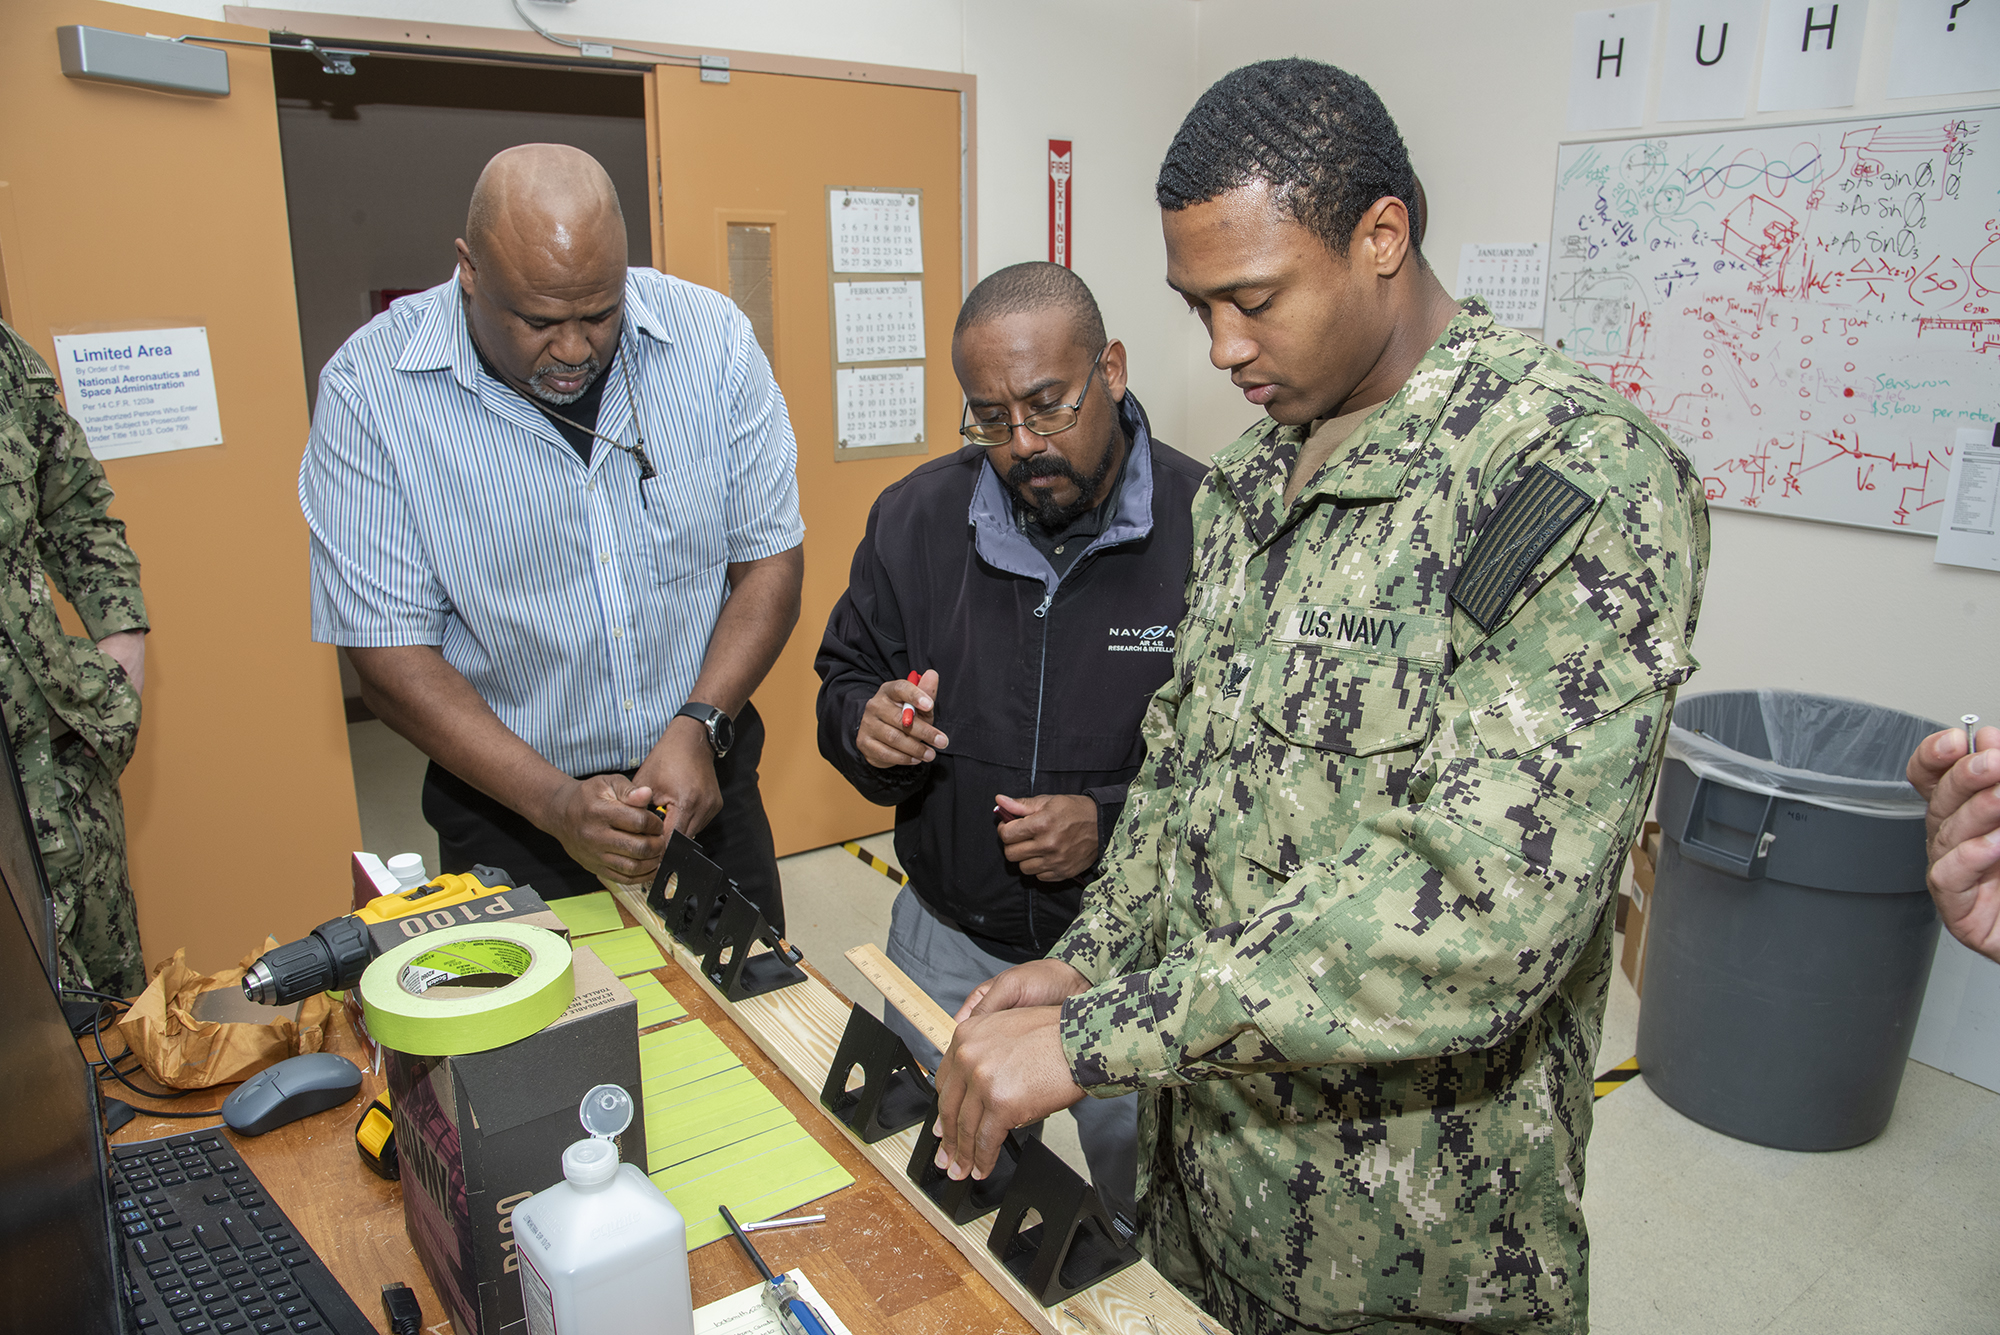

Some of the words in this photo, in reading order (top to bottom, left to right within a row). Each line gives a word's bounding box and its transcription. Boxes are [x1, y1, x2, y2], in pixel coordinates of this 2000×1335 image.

[1596, 37, 1624, 79] H
[1695, 23, 1728, 66] U
[1801, 4, 1838, 52] H
[1051, 161, 1069, 174] FIRE
[850, 198, 885, 206] ANUARY
[886, 199, 902, 207] 2020
[850, 287, 890, 295] FEBRUARY
[73, 346, 132, 362] Limited
[138, 345, 172, 357] Area
[78, 376, 120, 387] National
[123, 372, 180, 383] Aeronautics
[183, 369, 200, 378] and
[859, 374, 887, 382] MARCH
[888, 373, 903, 381] 2020
[1875, 373, 1950, 392] Sensuron
[81, 388, 111, 398] Space
[114, 381, 184, 394] Administration
[1932, 409, 1953, 423] per
[1959, 408, 1996, 423] meter
[1299, 610, 1332, 638] U.S.
[1337, 613, 1406, 648] NAVY
[399, 895, 514, 937] P100
[427, 974, 446, 986] Scotch
[582, 988, 610, 998] TOALLA
[583, 992, 613, 1005] JETABLE
[568, 997, 615, 1014] DISPOSABLE
